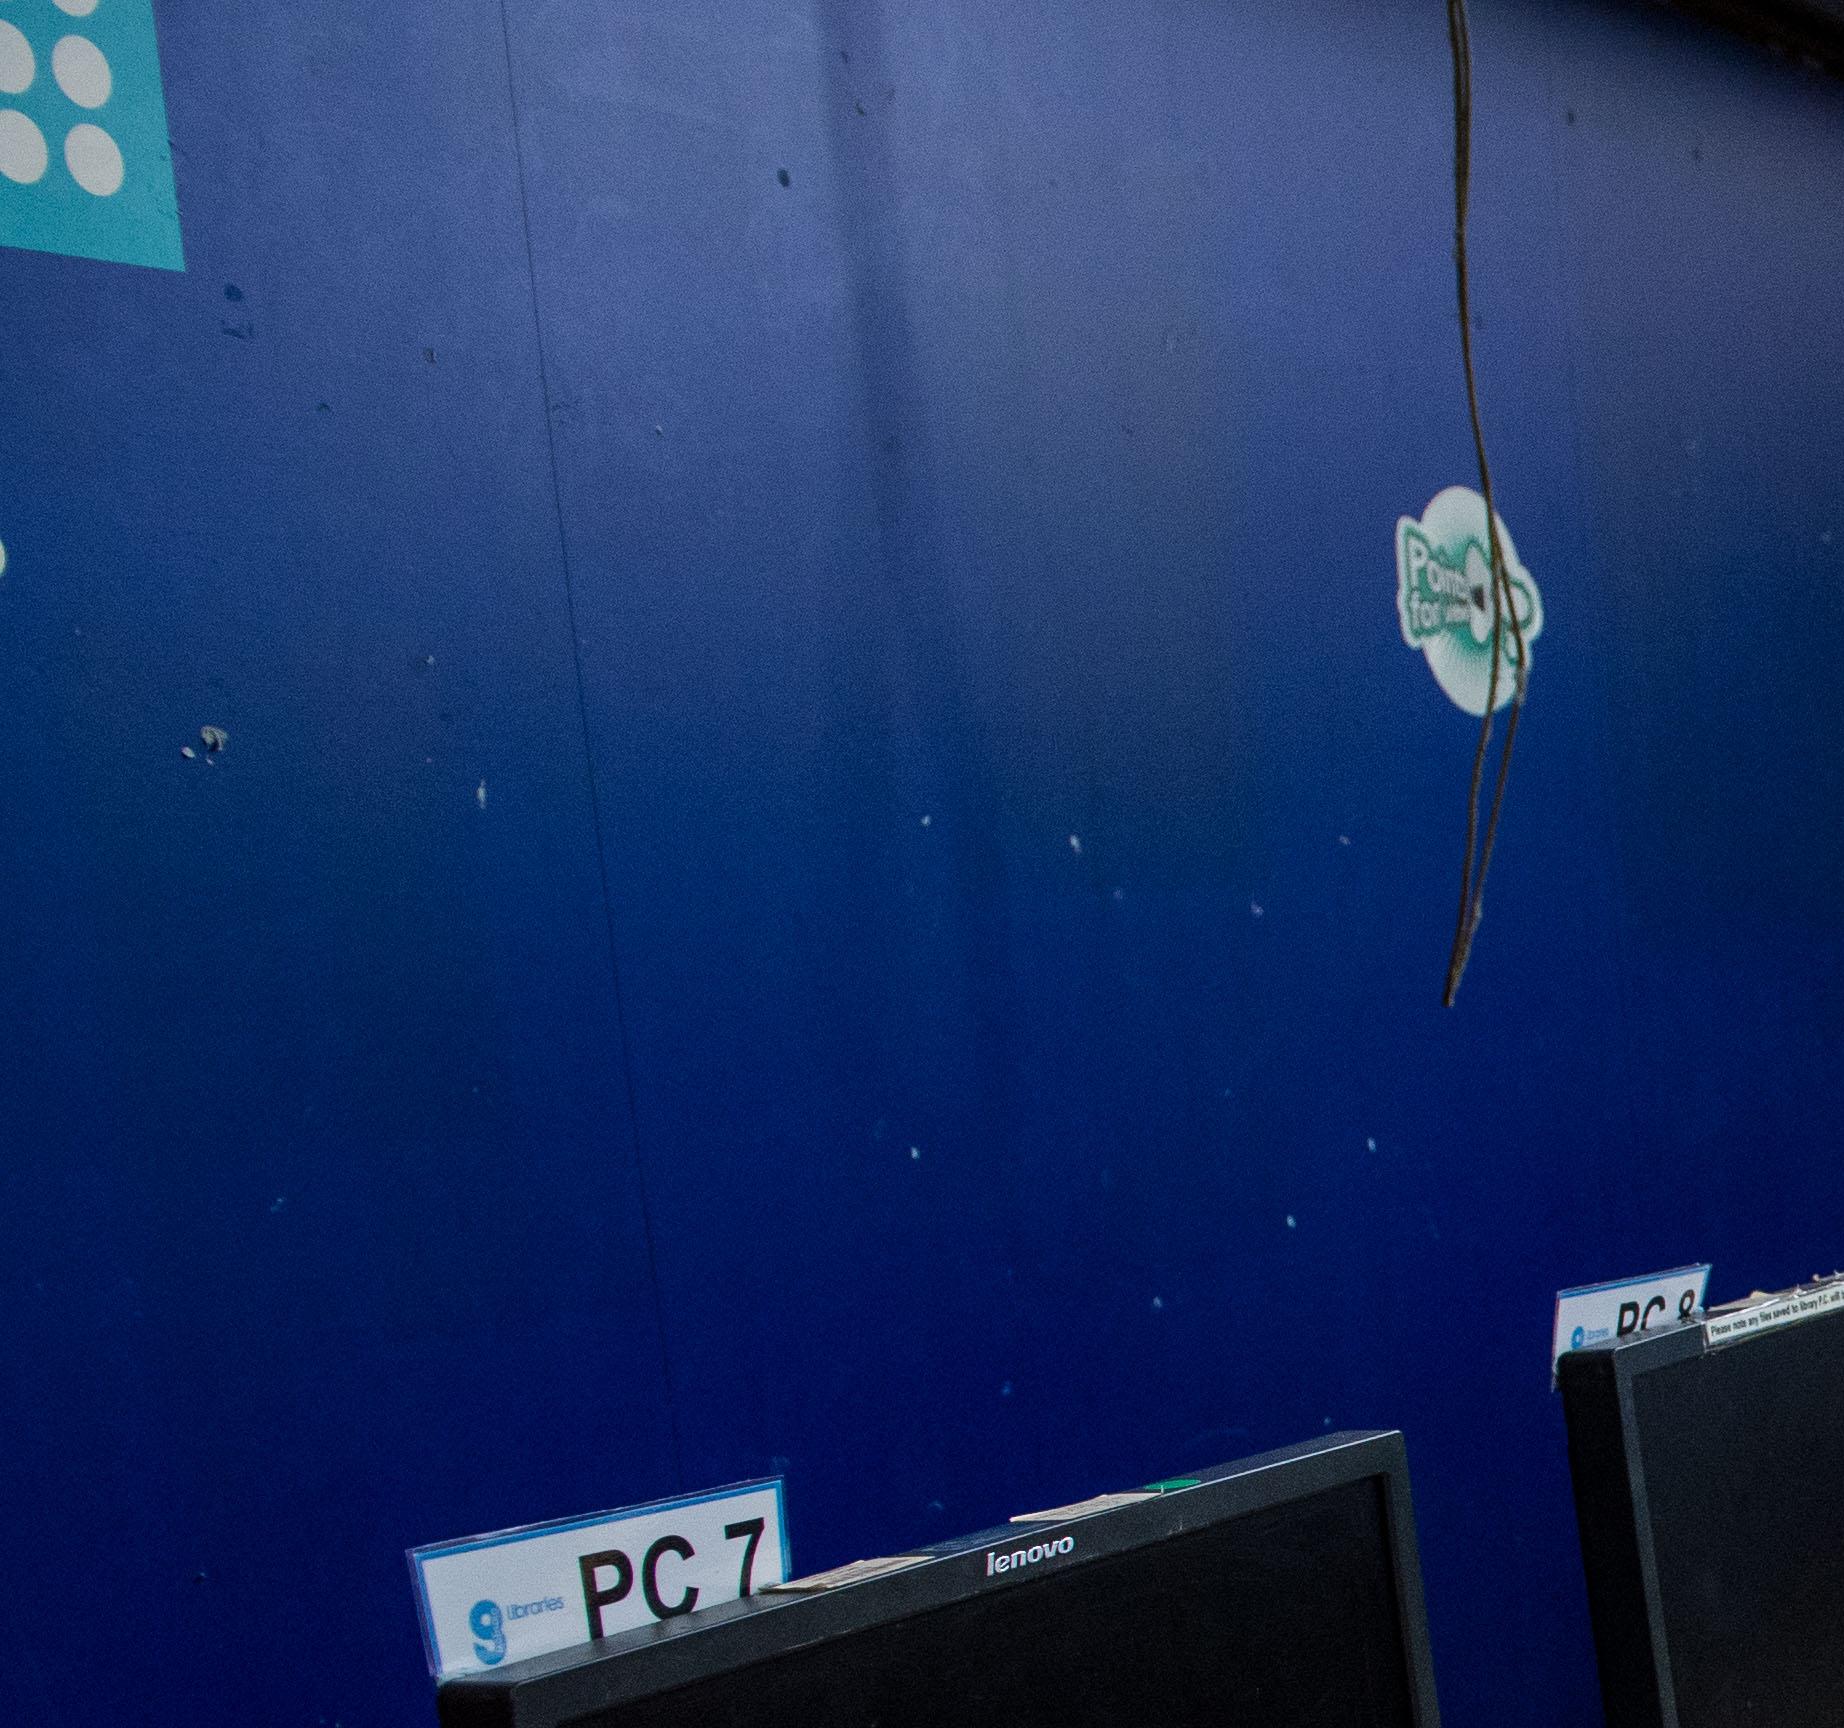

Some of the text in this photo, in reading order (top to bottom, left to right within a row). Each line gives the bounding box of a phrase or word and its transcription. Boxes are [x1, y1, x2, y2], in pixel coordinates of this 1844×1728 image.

[1616, 1295, 1665, 1337] PC
[1710, 1322, 1732, 1336] Please
[986, 1534, 1075, 1577] lenovo
[577, 1533, 701, 1642] PC
[725, 1516, 767, 1598] 7
